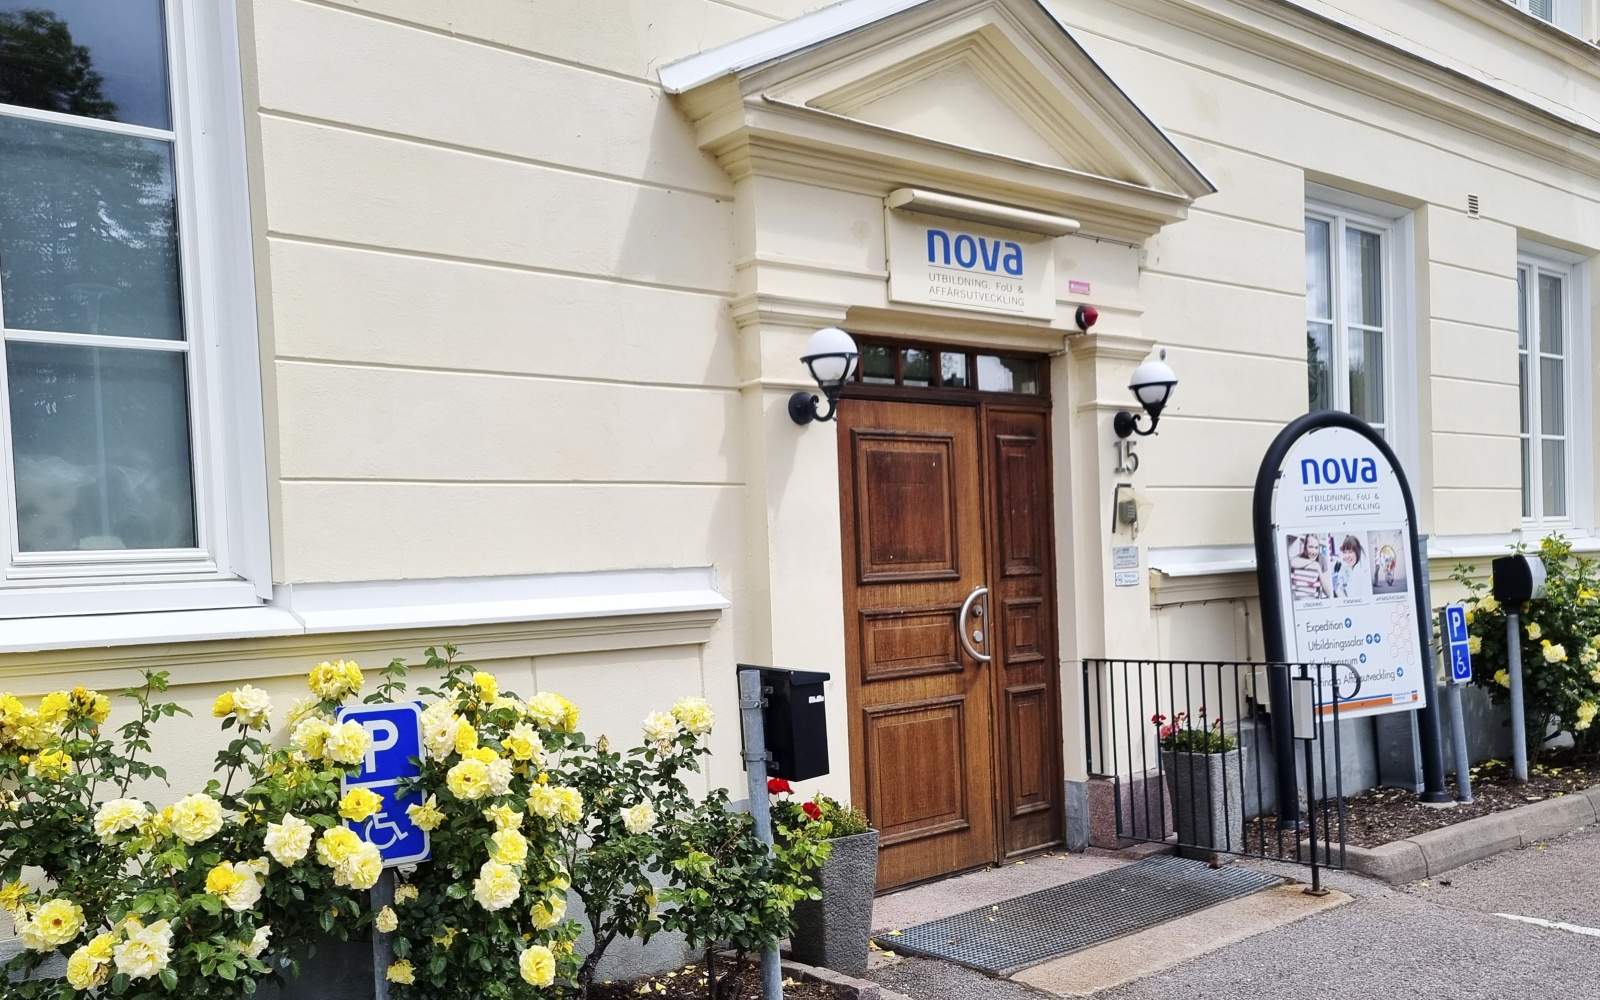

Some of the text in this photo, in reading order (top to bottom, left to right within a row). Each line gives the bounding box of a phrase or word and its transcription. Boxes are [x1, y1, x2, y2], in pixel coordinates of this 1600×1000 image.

[927, 229, 1023, 276] nova
[928, 273, 1024, 294] UTBILDNING, FoU &
[928, 285, 1025, 307] AFFÄRSUTVECKLING
[1114, 440, 1139, 474] 15
[1301, 457, 1377, 485] nova
[1304, 494, 1353, 503] UTBILDNING,
[1305, 502, 1380, 512] AFFÄRSUTVECKLING
[1306, 620, 1343, 634] Expedition
[1452, 612, 1461, 637] P
[1308, 635, 1364, 651] Utbildningssalar
[363, 719, 398, 773] P
